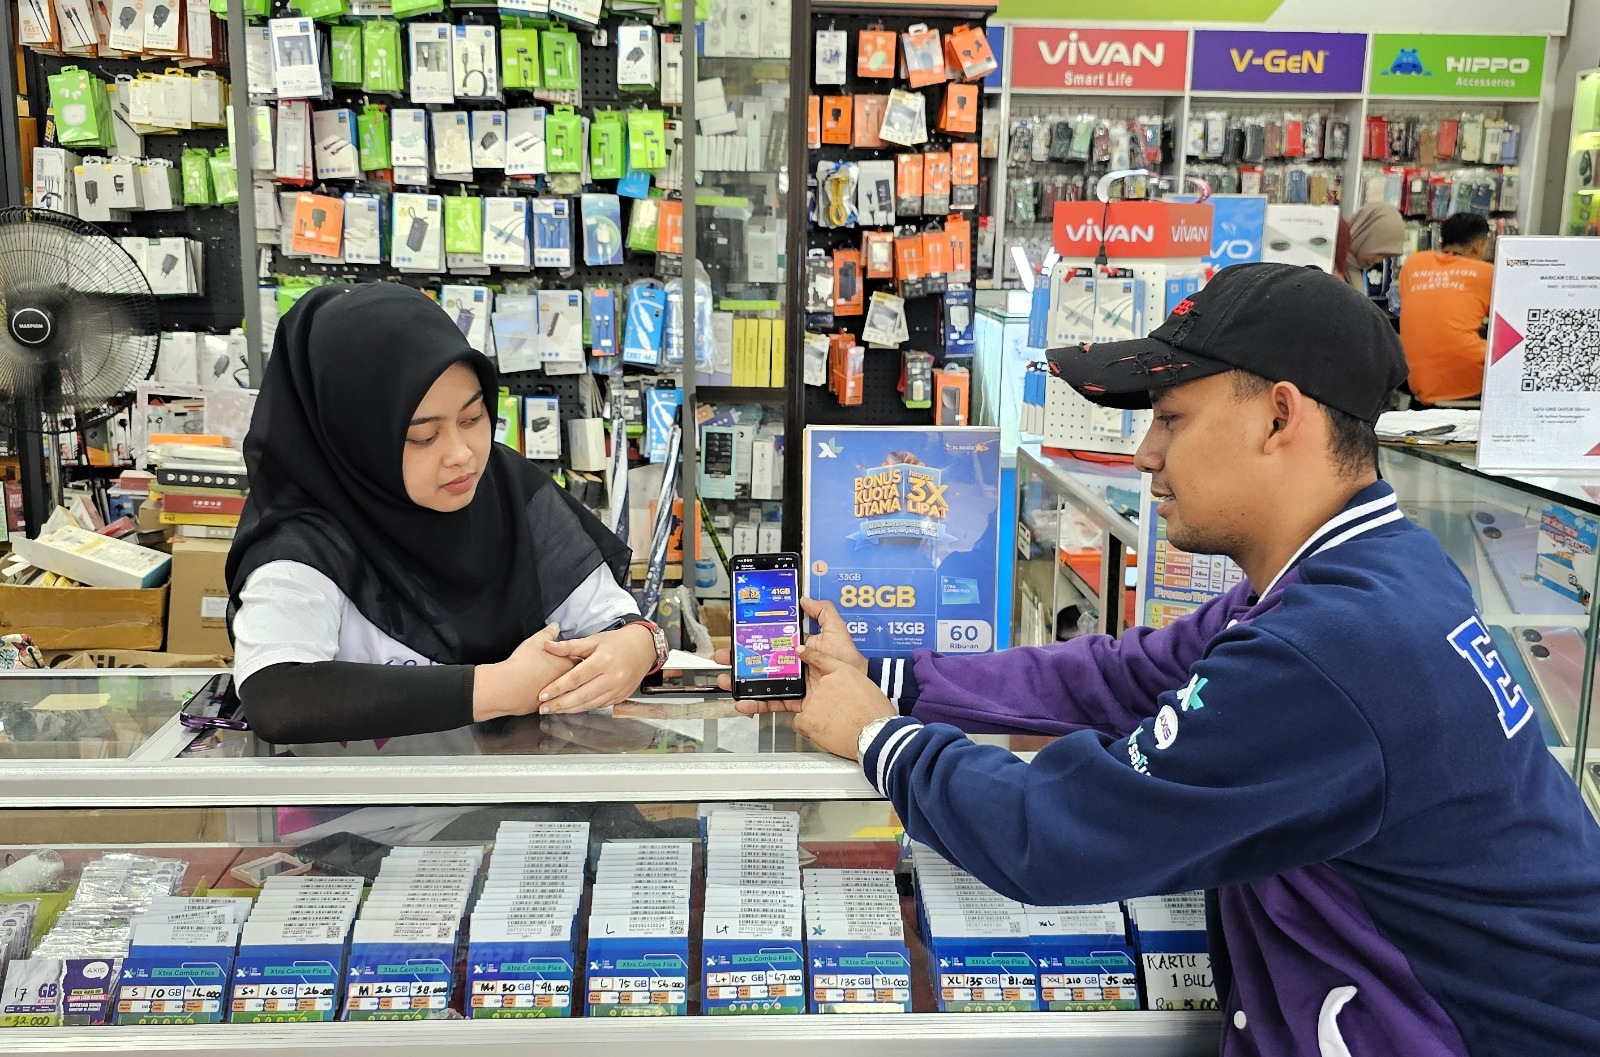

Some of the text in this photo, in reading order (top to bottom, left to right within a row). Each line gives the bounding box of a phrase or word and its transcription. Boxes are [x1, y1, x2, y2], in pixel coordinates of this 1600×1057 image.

[1446, 56, 1530, 74] HIPPO
[1064, 71, 1134, 86] Smart Life
[1455, 76, 1516, 88] Accessories
[1411, 269, 1478, 278] INNOVATION
[1411, 282, 1465, 292] EVERYONE
[854, 470, 902, 491] BONUS
[908, 470, 934, 482] hingga
[854, 484, 901, 504] KUOTA
[906, 478, 949, 508] 3X
[854, 498, 902, 518] UTAMA
[906, 501, 948, 519] LIPAT
[888, 528, 920, 536] Sepanjang
[816, 564, 824, 572] L
[840, 585, 916, 608] 88GB
[844, 622, 868, 634] GB
[888, 622, 926, 634] 13GB
[950, 626, 978, 641] 60
[1146, 954, 1196, 970] KARTU
[601, 979, 608, 988] L
[619, 979, 631, 988] 75
[948, 977, 962, 985] XL
[966, 977, 983, 986] 135
[1171, 973, 1214, 988] 1 BUL
[14, 983, 58, 1002] 17 GB
[151, 989, 165, 998] 10
[242, 987, 254, 995] S+
[266, 987, 277, 995] 16
[359, 986, 369, 995] M
[13, 1014, 50, 1026] 32.000
